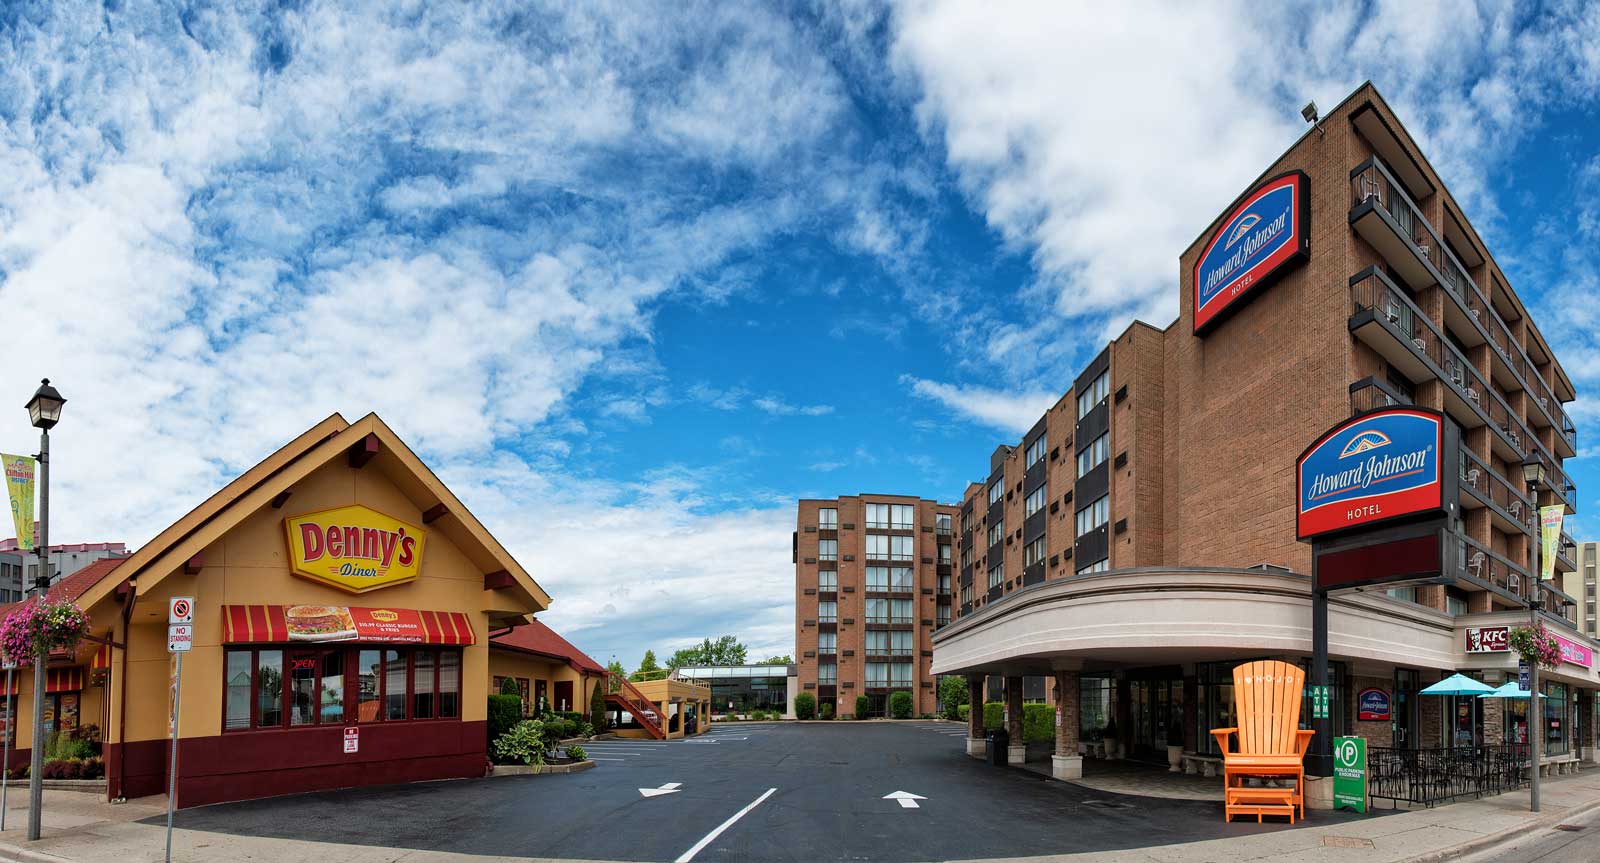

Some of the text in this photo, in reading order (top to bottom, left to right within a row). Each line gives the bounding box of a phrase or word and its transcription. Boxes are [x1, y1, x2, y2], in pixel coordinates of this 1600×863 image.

[1203, 212, 1286, 296] Howard Johnson
[1231, 274, 1254, 296] HOTEL
[1308, 448, 1427, 500] Howard Johnson
[1347, 504, 1382, 520] HOTEL
[299, 522, 416, 569] Denny's
[340, 562, 377, 576] Diner
[1482, 630, 1507, 642] KFC
[1345, 746, 1354, 760] P
